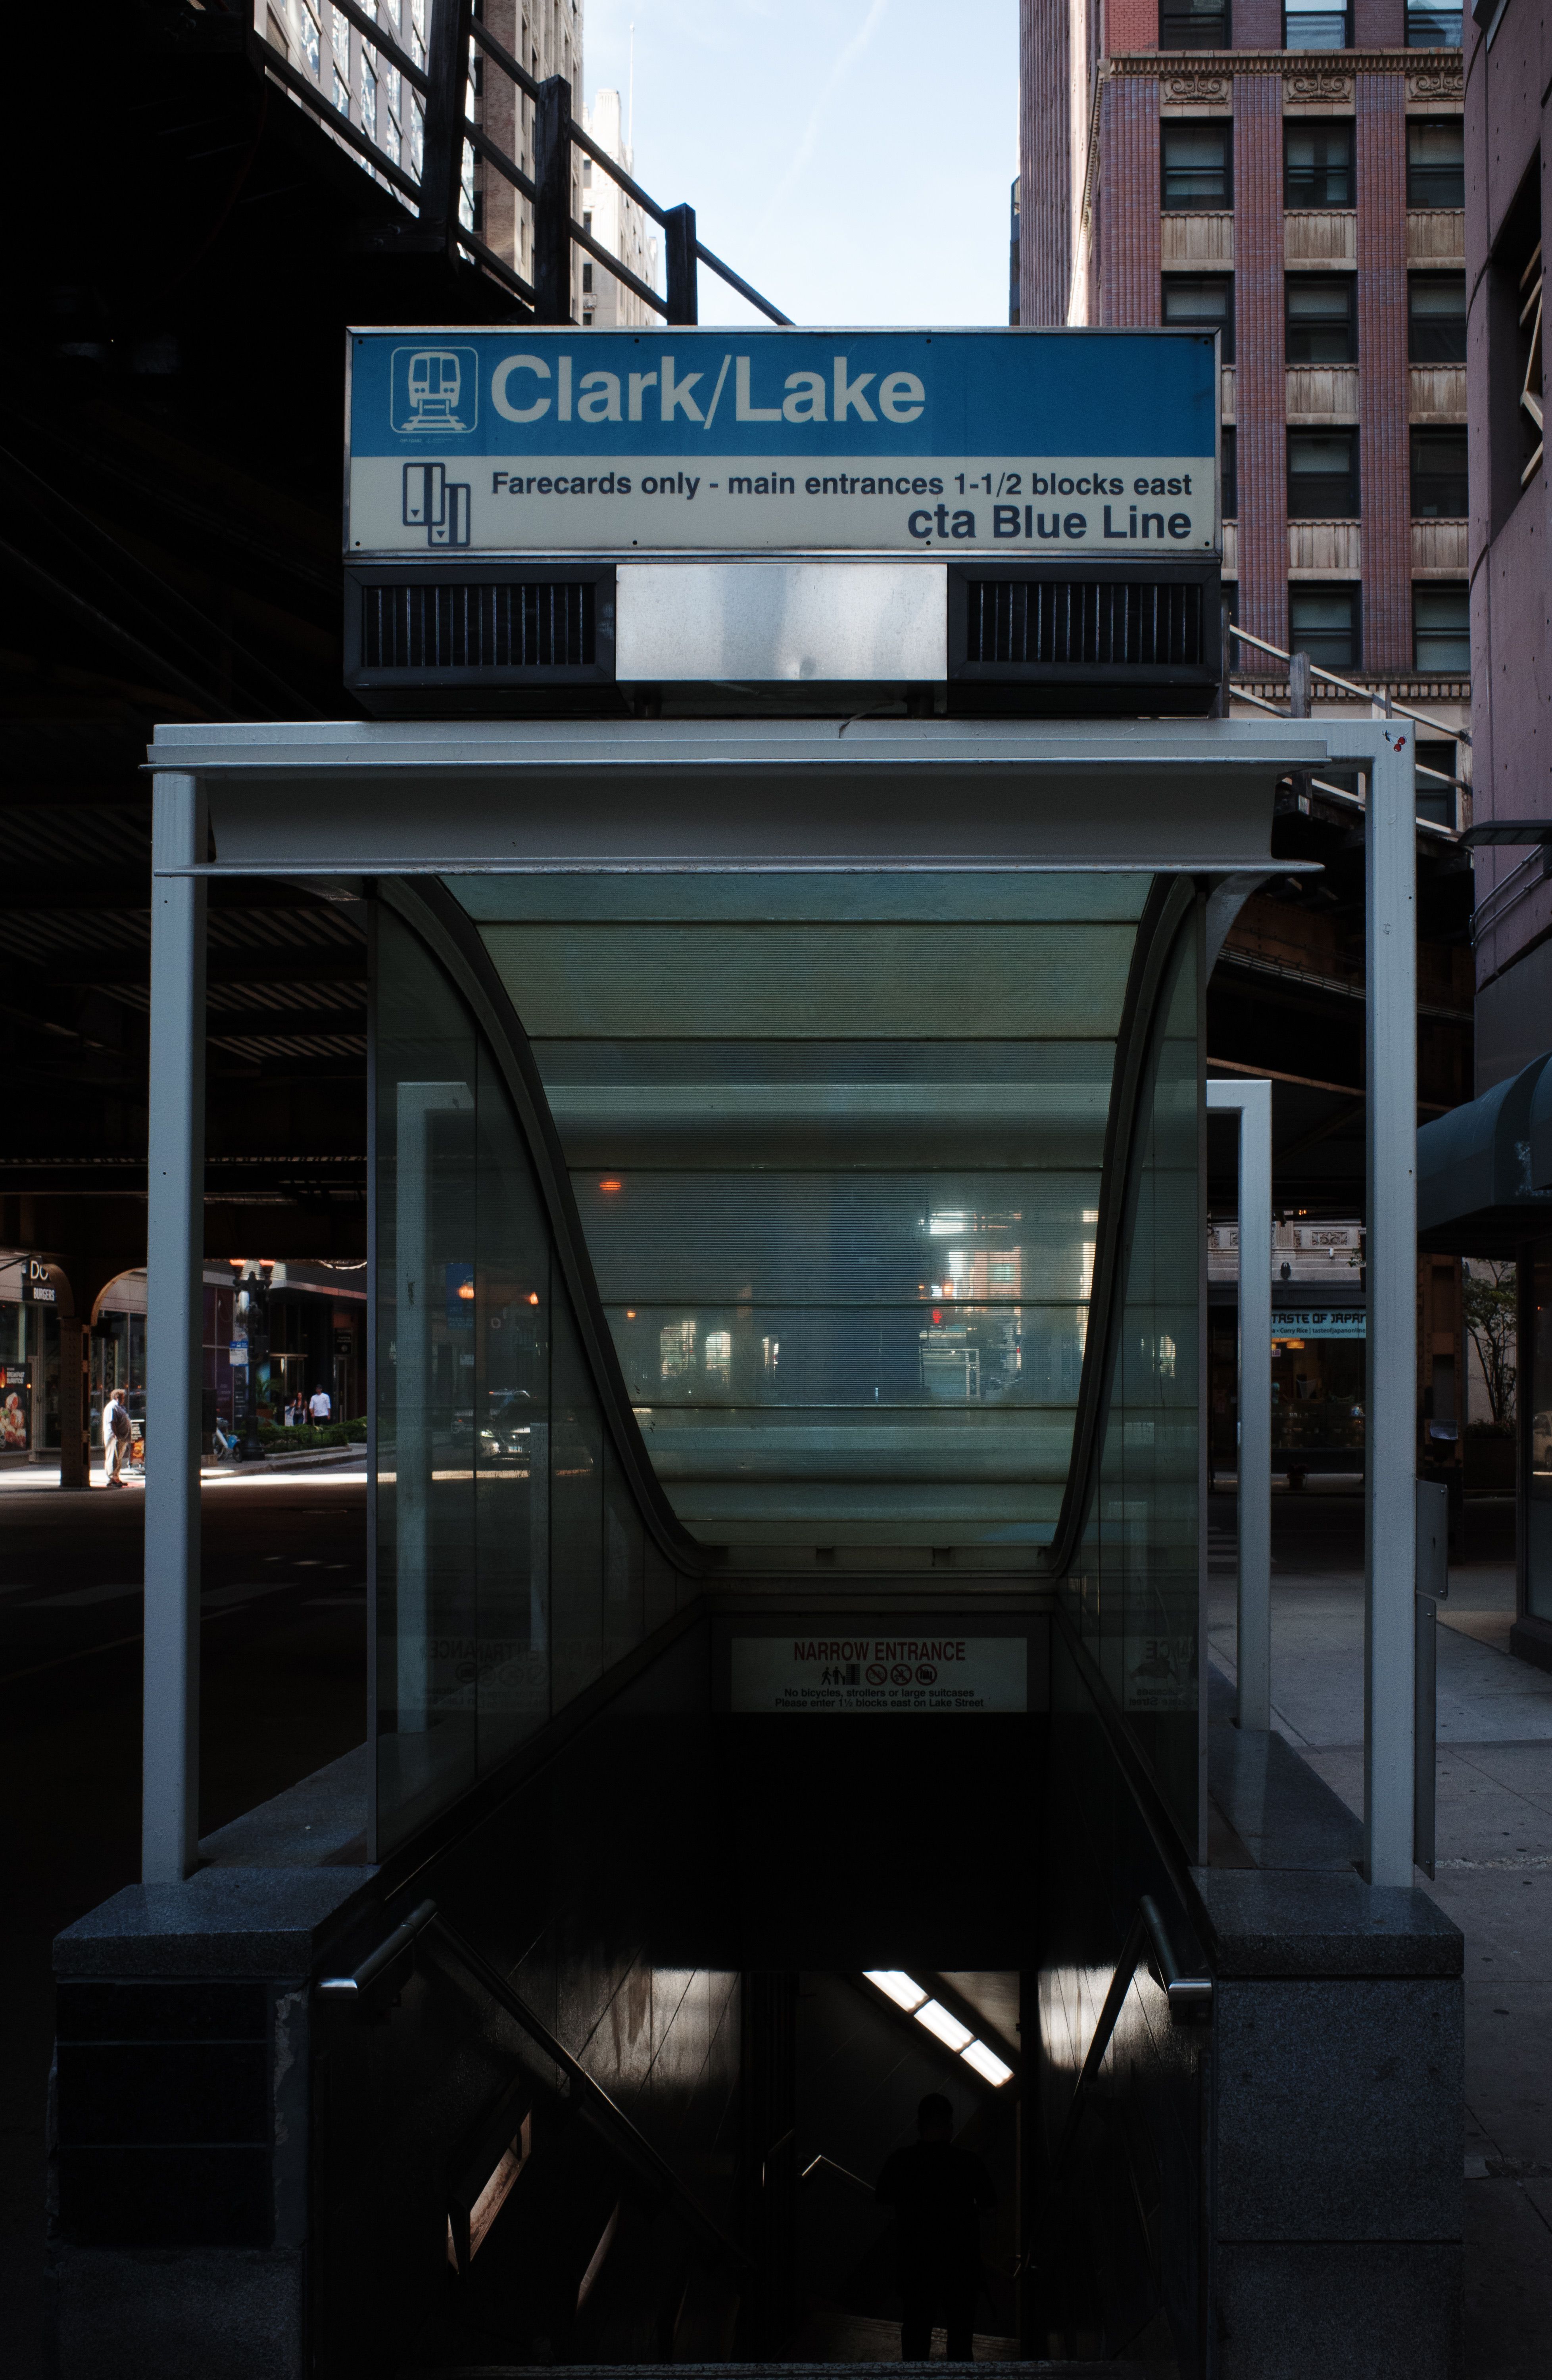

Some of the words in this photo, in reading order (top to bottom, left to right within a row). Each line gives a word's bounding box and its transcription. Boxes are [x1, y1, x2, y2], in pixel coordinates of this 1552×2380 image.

[491, 355, 926, 430] Clark/Lake
[492, 472, 632, 495] Farecards
[642, 472, 700, 500] only
[729, 472, 795, 495] main
[805, 474, 943, 495] entrances
[955, 473, 1022, 497] 1-1/2
[1032, 473, 1124, 495] blocks
[1133, 474, 1192, 496] east
[908, 504, 976, 540] cta
[994, 505, 1087, 540] Blue
[1103, 505, 1192, 540] Line
[33, 1287, 55, 1301] BURGERS
[1272, 1313, 1309, 1323] TASTE
[1312, 1313, 1327, 1323] OF
[794, 1641, 869, 1661] NARROW
[875, 1641, 965, 1661] ENTRANCE
[784, 1688, 799, 1697] No
[801, 1688, 843, 1699] bicycles,
[846, 1688, 886, 1697] strollers
[901, 1688, 926, 1699] large
[929, 1688, 974, 1697] suitcases
[775, 1698, 808, 1707] Please
[856, 1698, 888, 1707] blocks
[890, 1699, 911, 1707] east
[929, 1699, 952, 1707] Lake
[955, 1698, 984, 1707] Street
